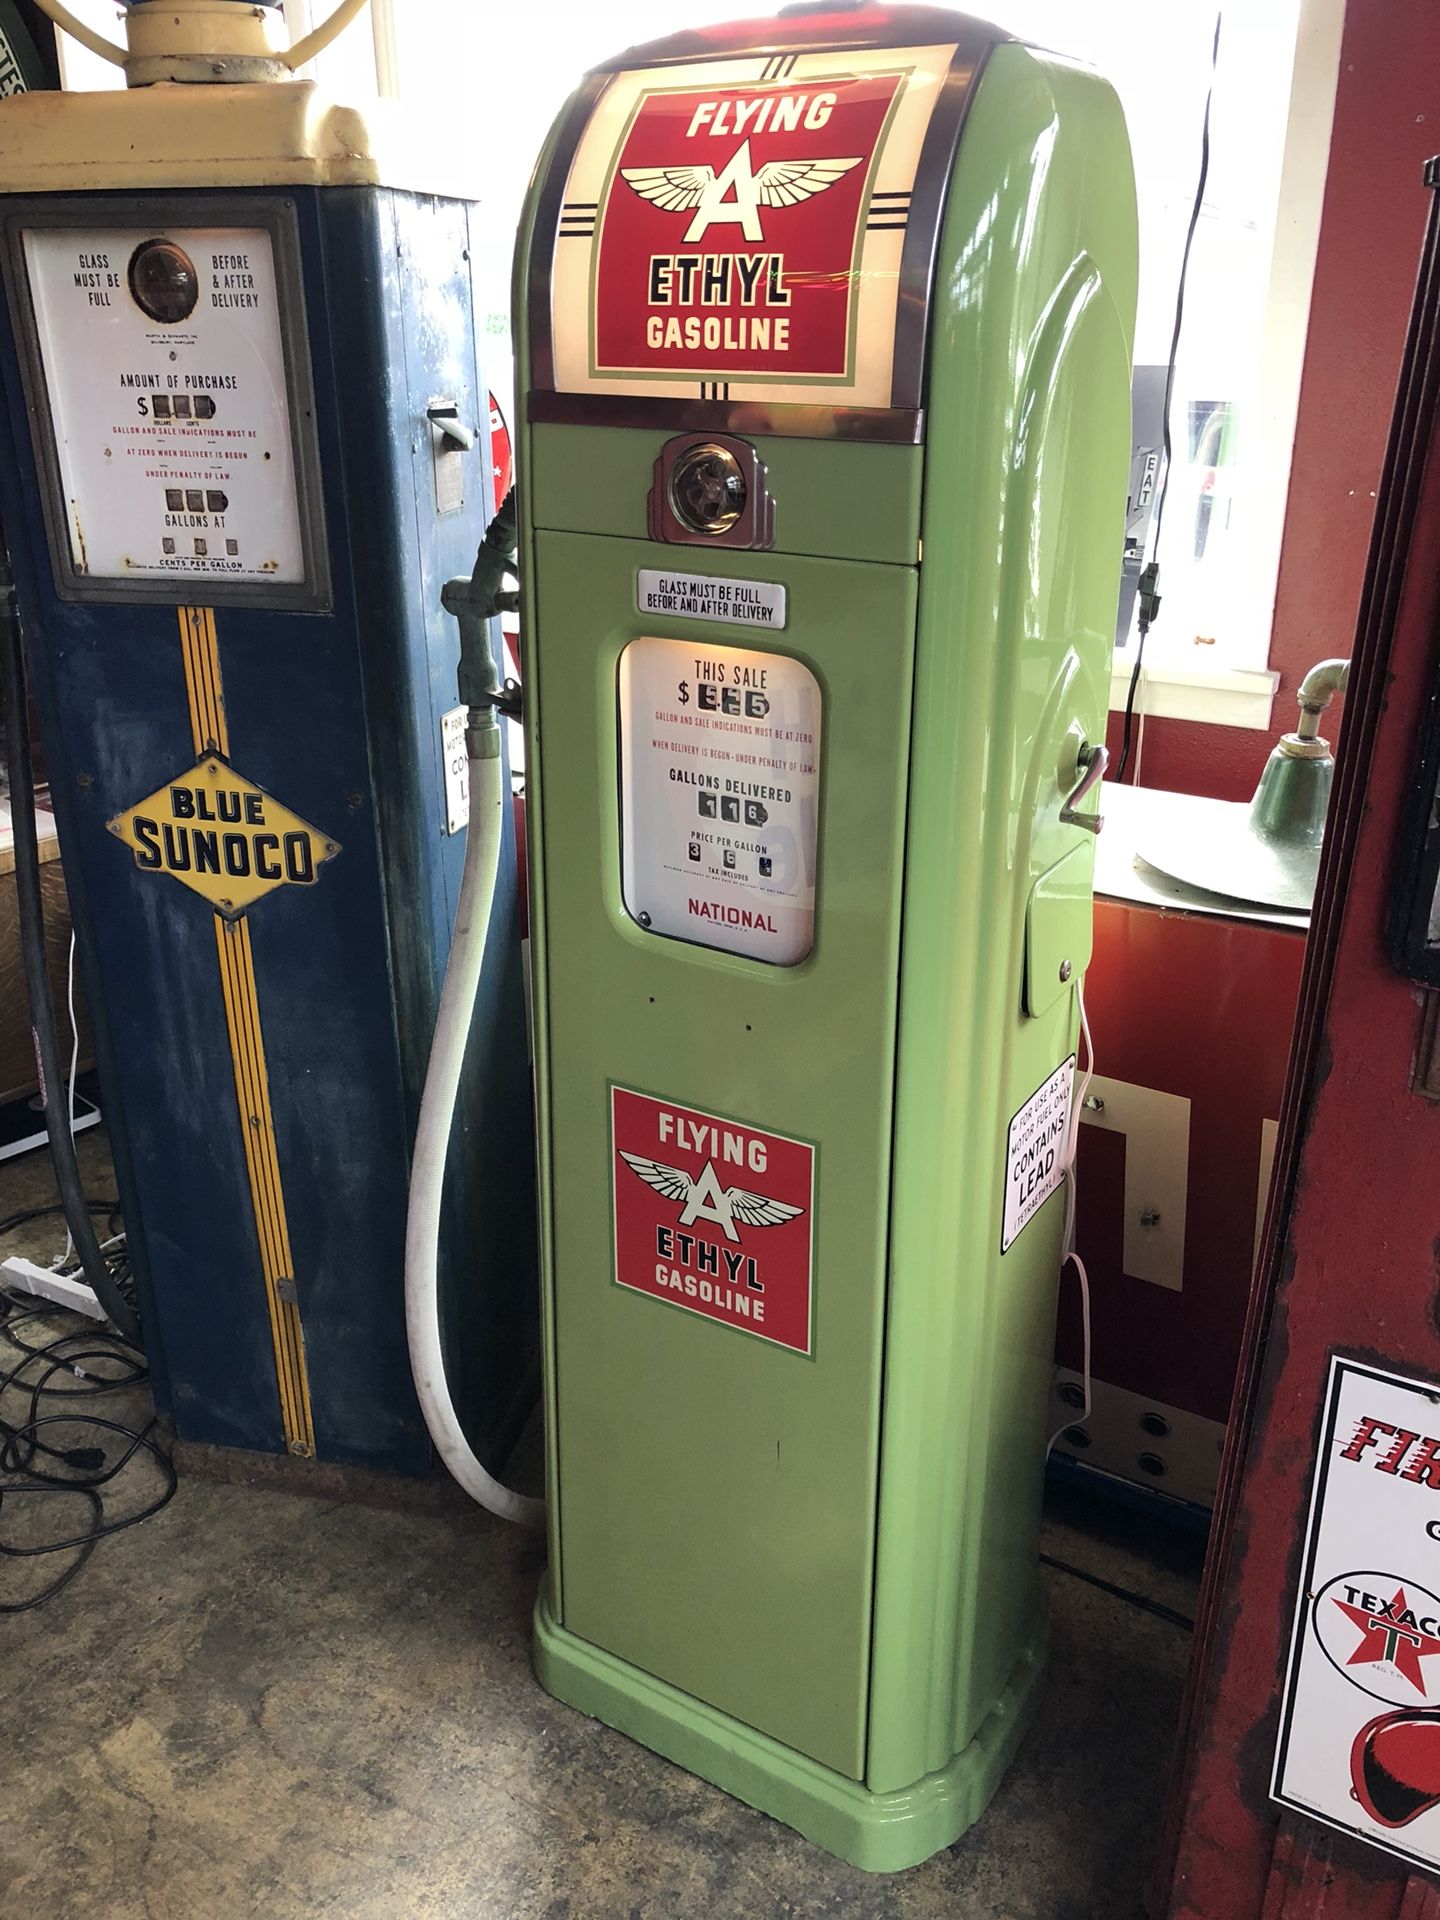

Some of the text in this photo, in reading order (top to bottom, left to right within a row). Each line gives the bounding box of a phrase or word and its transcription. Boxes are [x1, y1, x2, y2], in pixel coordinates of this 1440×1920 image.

[686, 92, 837, 138] FLYING
[681, 136, 765, 244] A
[79, 254, 109, 269] GLASS
[213, 255, 249, 270] BEFORE
[74, 273, 120, 288] MUST BE
[224, 275, 255, 289] AFTER
[648, 254, 791, 307] ETHYL
[89, 292, 111, 306] FULL
[212, 294, 259, 308] DELIVERY
[647, 317, 789, 351] GASOLINE
[121, 374, 238, 389] AMOUNT OF PURCHASE
[137, 396, 148, 417] $
[113, 426, 140, 434] GALLON
[138, 449, 156, 457] ZERO
[180, 450, 213, 459] DELIVERY
[146, 470, 168, 478] UNDER
[170, 471, 202, 479] PENALTY
[205, 472, 213, 480] OF
[1143, 457, 1156, 504] EAT
[165, 514, 225, 528] GALLONS AT
[191, 560, 206, 568] PER
[210, 561, 243, 569] GALLON
[659, 579, 761, 604] GLASS MUST BE FULL
[648, 594, 774, 622] BEFORE AND AFTER DELIVERY
[695, 660, 767, 689] THIS SALE
[678, 680, 690, 706] $
[656, 712, 813, 744] GALLON AND SALE INDICATIONS MUST BE AT ZERO
[652, 740, 669, 750] WHEN
[671, 742, 699, 755] DELIVERY
[701, 747, 708, 757] IS
[736, 754, 756, 765] UNDER
[759, 756, 787, 770] PENALTY
[789, 762, 797, 772] OF
[670, 768, 792, 803] GALLONS DELIVERED
[170, 786, 266, 826] BLUE
[133, 816, 314, 883] SUNOCO
[691, 831, 767, 855] PRICE PER GALLON
[708, 867, 749, 882] TAX INCLUDED
[689, 898, 778, 933] NATIONAL
[1020, 1073, 1065, 1131] FOR USE AS A
[1012, 1083, 1071, 1157] MOTOR FUEL ONLY
[660, 1112, 768, 1174] FLYING
[1014, 1112, 1064, 1182] CONTAINS
[1020, 1148, 1054, 1207] LEAD
[677, 1159, 742, 1245] A
[657, 1225, 765, 1293] ETHYL
[655, 1264, 765, 1322] GASOLINE
[1344, 1585, 1440, 1637] TEXAC
